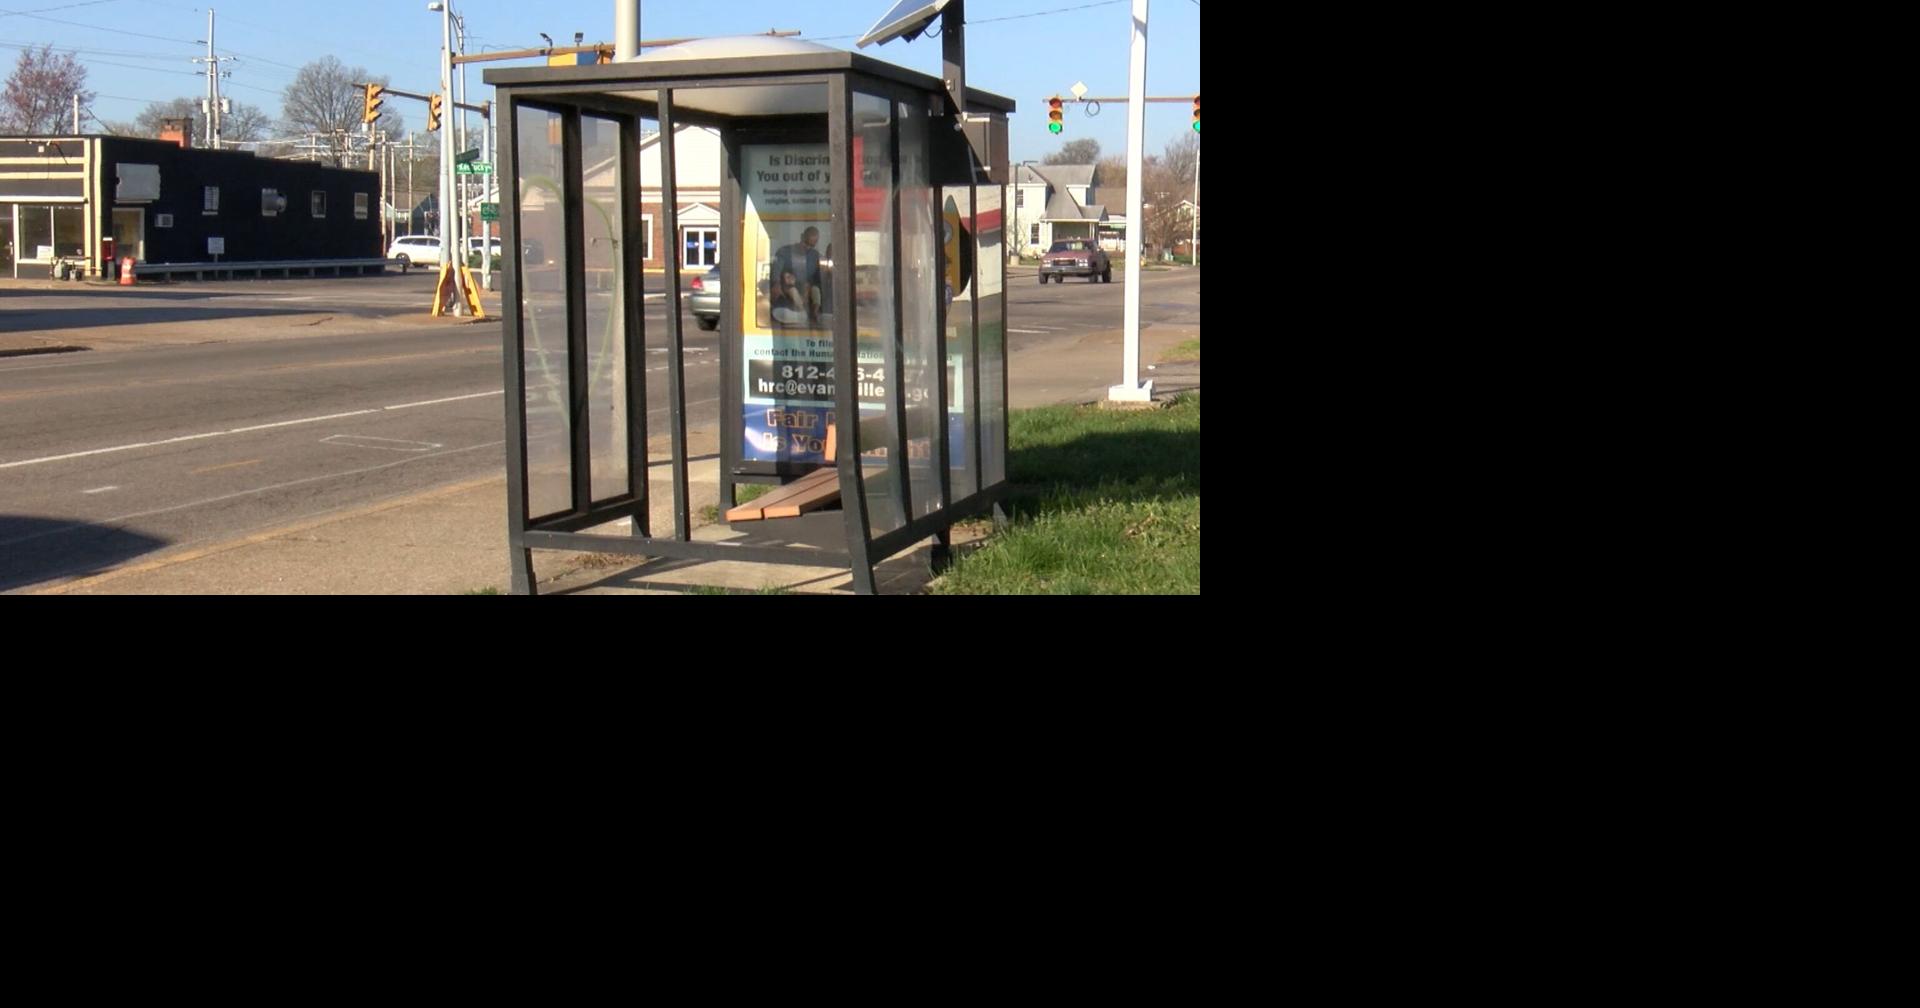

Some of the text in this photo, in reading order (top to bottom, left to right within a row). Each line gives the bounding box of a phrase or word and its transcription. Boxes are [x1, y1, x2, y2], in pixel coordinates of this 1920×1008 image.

[769, 155, 780, 166] Is
[757, 170, 779, 182] You
[783, 171, 803, 182] out
[808, 170, 820, 181] of
[754, 348, 788, 357] contact
[791, 348, 806, 356] the
[767, 408, 819, 429] Fair
